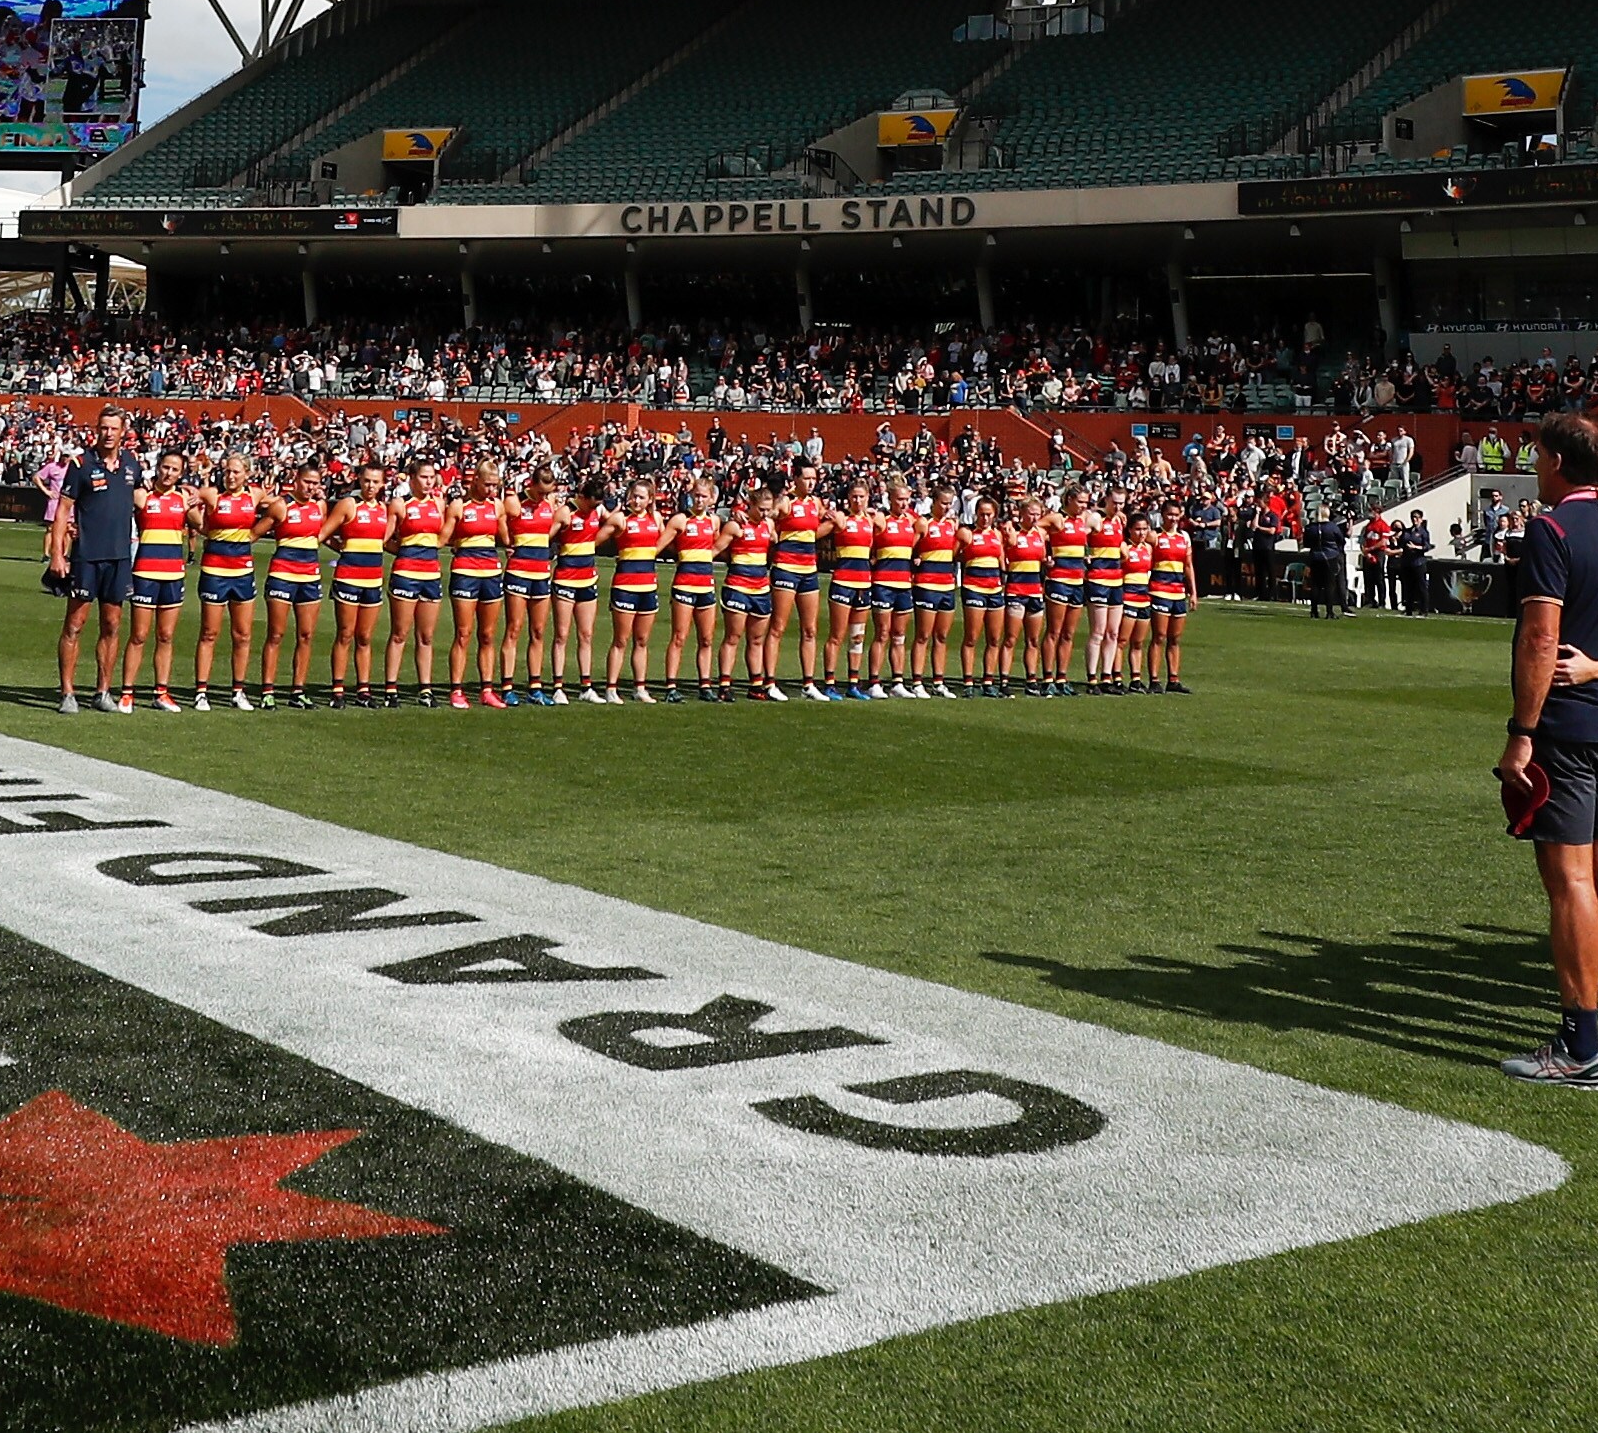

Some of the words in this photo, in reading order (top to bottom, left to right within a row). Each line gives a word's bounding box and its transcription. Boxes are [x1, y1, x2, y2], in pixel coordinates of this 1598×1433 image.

[1, 132, 66, 146] FINAL
[620, 203, 821, 233] CHAPPELL
[840, 196, 976, 229] STAND
[1442, 324, 1486, 332] HYUNDAI
[1513, 323, 1558, 331] HYUNDAI
[96, 850, 1110, 1158] GRAND
